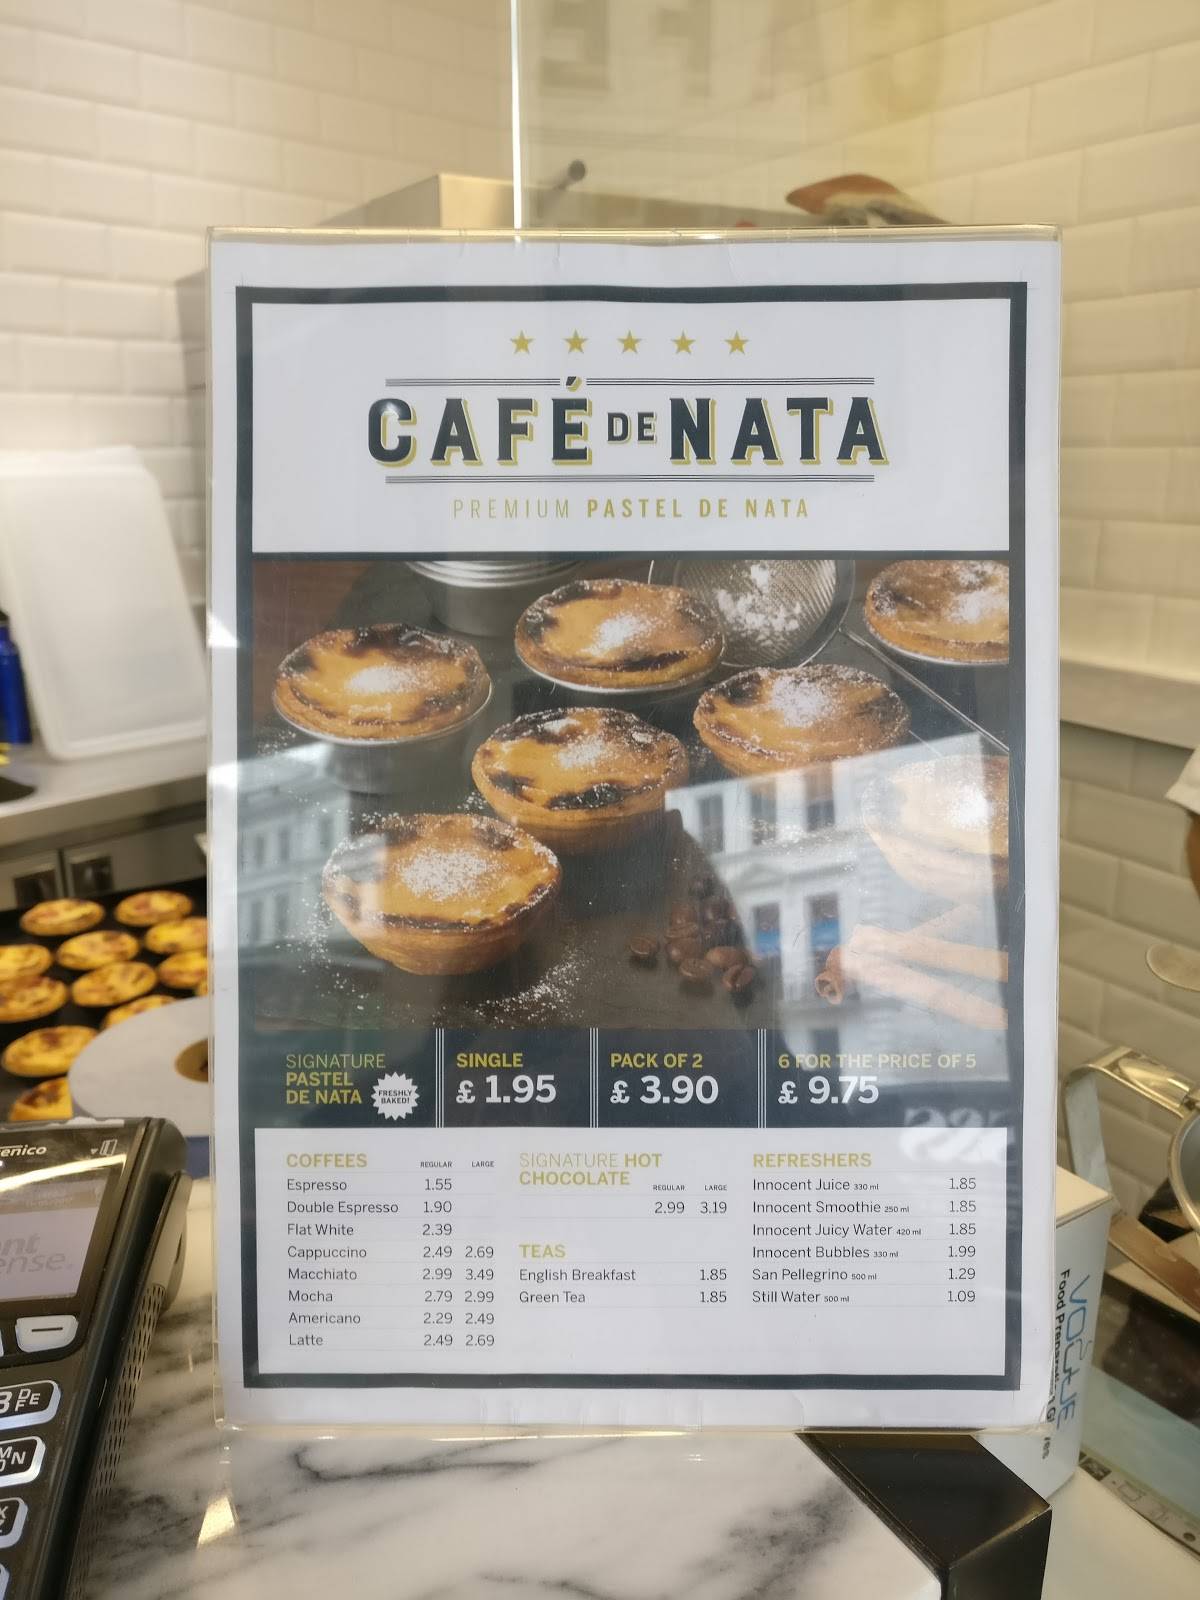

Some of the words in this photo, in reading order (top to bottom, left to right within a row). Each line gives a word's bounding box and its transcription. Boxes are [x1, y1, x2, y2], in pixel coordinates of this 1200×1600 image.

[368, 376, 595, 467] CAFÉ
[608, 412, 657, 443] DE
[670, 397, 889, 465] NATA
[454, 498, 568, 518] PREMIUM
[587, 498, 681, 518] PASTEL
[700, 499, 727, 518] DE
[745, 499, 807, 517] NATA
[286, 1054, 386, 1068] SIGNATURE
[457, 1053, 523, 1067] SINGLE
[611, 1053, 658, 1068] PACK
[664, 1053, 688, 1068] OF
[692, 1054, 702, 1068] 2
[778, 1054, 790, 1068] 6
[795, 1054, 831, 1068] FOR
[836, 1054, 874, 1068] THE
[878, 1054, 931, 1068] PRICE
[937, 1054, 962, 1068] OF
[966, 1054, 977, 1068] 5
[287, 1072, 353, 1086] PASTEL
[456, 1080, 475, 1103] £
[486, 1075, 556, 1103] 1.95
[610, 1080, 630, 1103] £
[640, 1075, 718, 1104] 3.90
[778, 1081, 798, 1104] £
[808, 1076, 879, 1104] 9.75
[287, 1090, 310, 1104] DE
[316, 1089, 362, 1104] NATA
[287, 1153, 367, 1168] COFFEES
[471, 1160, 495, 1168] LARGE
[519, 1153, 618, 1168] SIGNATURE
[625, 1153, 661, 1168] HOT
[753, 1153, 871, 1168] REFRESHERS
[288, 1179, 347, 1192] Espresso
[425, 1178, 452, 1190] 1.55
[520, 1171, 629, 1185] CHOCOLATE
[652, 1184, 685, 1192] REGULAR
[754, 1179, 811, 1190] Innocent
[816, 1179, 849, 1190] Juice
[853, 1183, 869, 1191] 330
[869, 1183, 879, 1191] ml
[950, 1178, 976, 1189] 1.85
[288, 1201, 333, 1212] Double
[339, 1201, 398, 1215] Espresso
[424, 1201, 452, 1212] 1.90
[655, 1202, 684, 1213] 2.99
[701, 1202, 727, 1213] 3.19
[754, 1201, 811, 1212] Innocent
[816, 1201, 880, 1212] Smoothie
[884, 1205, 899, 1213] 250
[950, 1200, 976, 1212] 1.85
[288, 1224, 312, 1235] Flat
[316, 1224, 353, 1235] White
[423, 1224, 452, 1235] 2.39
[754, 1224, 811, 1235] Innocent
[815, 1224, 849, 1238] Juicy
[853, 1224, 892, 1235] Water
[896, 1228, 911, 1236] 420
[911, 1228, 922, 1236] ml
[950, 1223, 976, 1235] 1.85
[288, 1246, 366, 1260] Cappuccino
[424, 1246, 452, 1258] 2.49
[465, 1246, 493, 1258] 2.69
[519, 1244, 565, 1258] TEAS
[753, 1247, 811, 1258] Innocent
[816, 1246, 869, 1257] Bubbles
[873, 1250, 888, 1258] 330
[889, 1250, 899, 1258] ml
[949, 1246, 975, 1257] 1.99
[289, 1268, 357, 1280] Macchiato
[423, 1268, 452, 1280] 2.99
[466, 1269, 493, 1280] 3.49
[520, 1269, 567, 1283] English
[573, 1269, 635, 1280] Breakfast
[700, 1269, 726, 1280] 1.85
[753, 1269, 777, 1280] San
[783, 1269, 847, 1282] Pellegrino
[851, 1273, 866, 1281] 500
[949, 1268, 975, 1279] 1.29
[289, 1290, 332, 1301] Mocha
[425, 1290, 452, 1302] 2.79
[465, 1290, 494, 1302] 2.99
[1056, 1269, 1070, 1310] Food
[520, 1291, 559, 1302] Green
[563, 1291, 585, 1302] Tea
[701, 1291, 726, 1303] 1.85
[753, 1291, 777, 1302] Still
[781, 1291, 820, 1302] Water
[824, 1295, 839, 1303] 500
[840, 1295, 850, 1303] ml
[948, 1291, 975, 1302] 1.09
[289, 1312, 360, 1323] Americano
[424, 1312, 452, 1324] 2.29
[465, 1313, 494, 1324] 2.49
[290, 1334, 323, 1345] Latte
[424, 1335, 452, 1346] 2.49
[466, 1335, 494, 1346] 2.69
